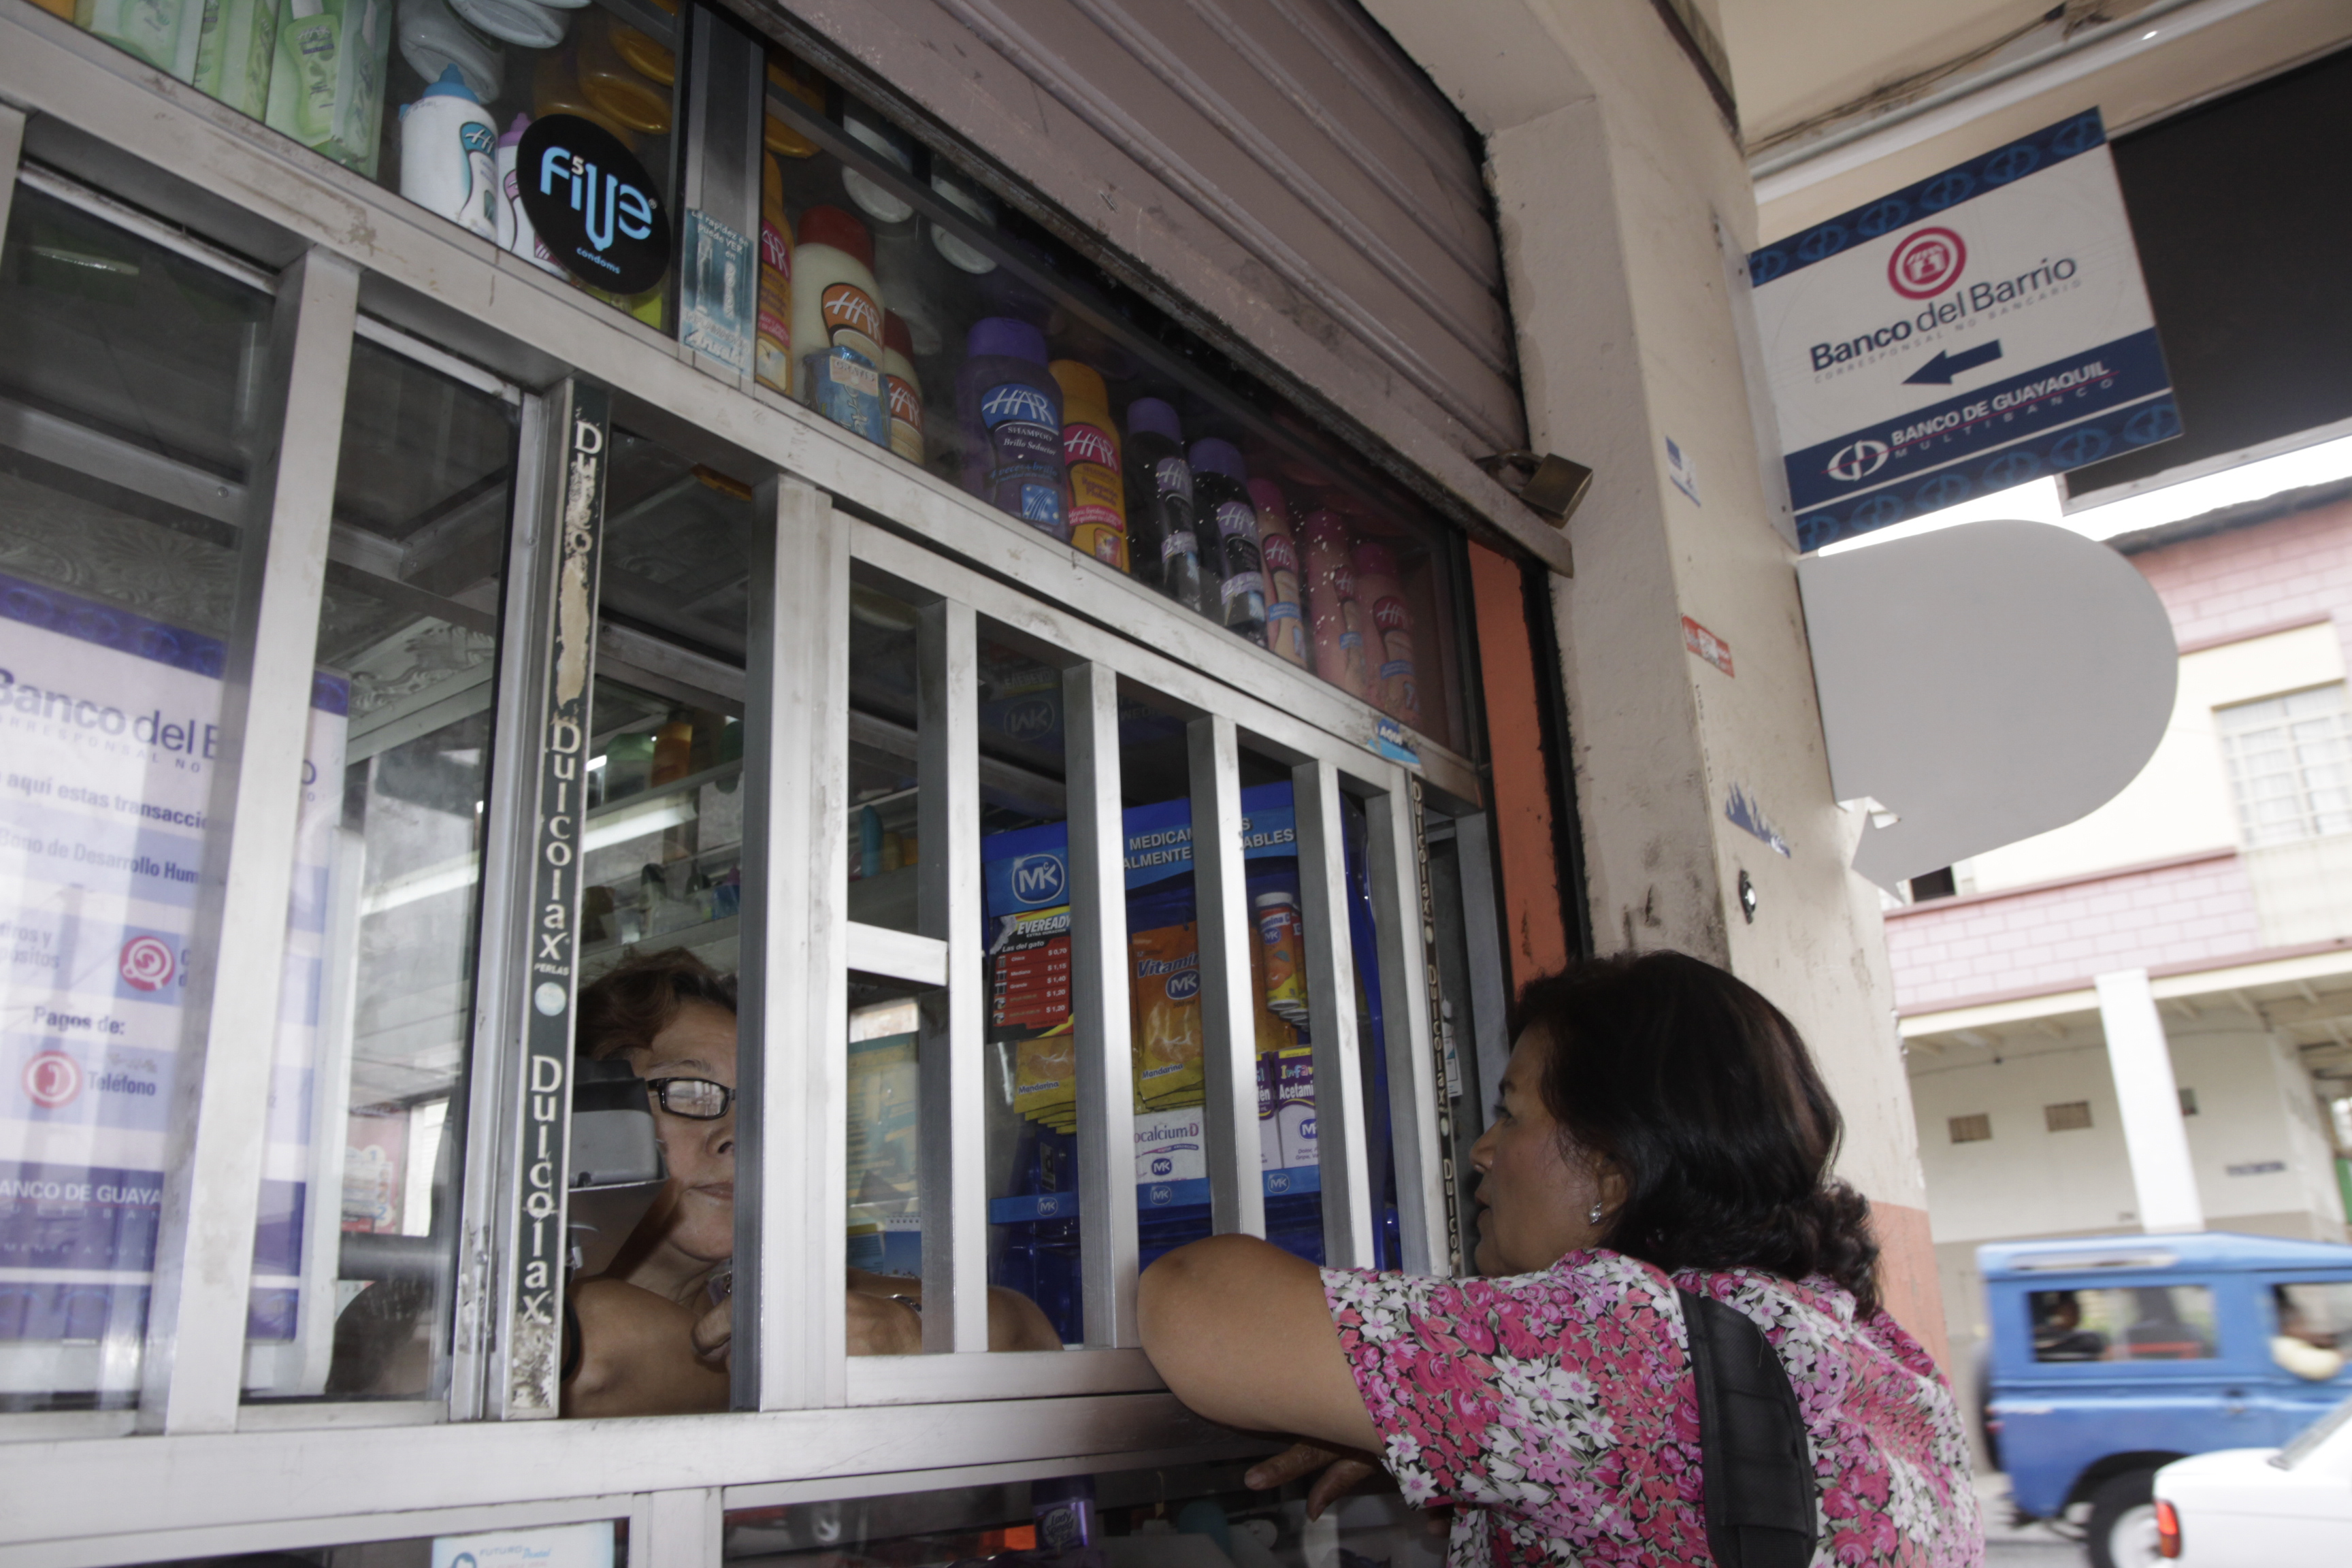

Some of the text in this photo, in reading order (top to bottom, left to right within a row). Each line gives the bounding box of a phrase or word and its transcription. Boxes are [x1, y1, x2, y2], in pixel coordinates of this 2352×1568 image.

[698, 223, 743, 256] puede VER
[576, 246, 621, 274] condoms
[1810, 257, 2078, 373] Banco del Barrio
[1814, 278, 2082, 385] CORRESPONSAL NO BANCARIO
[1891, 361, 2111, 446] BANCO DE GUAYAQUIL
[1895, 377, 2114, 460] MULTIBANCO
[1008, 426, 1053, 442] SHAMPOO
[1003, 438, 1057, 456] Brillo Seductor
[133, 708, 197, 755] del
[175, 758, 201, 774] NO
[7, 772, 52, 797] aquí
[57, 783, 110, 808] estas
[538, 722, 581, 961] Dulcolax
[48, 838, 69, 859] de
[73, 842, 161, 877] Desarrollo
[164, 861, 200, 884] Hum
[1124, 846, 1192, 870] ALMENTE
[1017, 915, 1071, 936] EVEREADY
[1016, 943, 1027, 951] del
[1028, 940, 1045, 950] gato
[534, 962, 570, 977] PERLAS
[33, 1004, 127, 1035] Pagos de:
[87, 1071, 157, 1096] Teléfono
[1142, 1063, 1185, 1080] Mandarina
[1018, 1081, 1060, 1095] Mandarina
[1279, 1081, 1314, 1100] Acetami
[1134, 1124, 1188, 1144] ocalcium
[0, 1178, 162, 1205] ANCO DE GUAYA
[523, 1055, 563, 1326] Dulcolax
[1046, 1518, 1074, 1538] Speed
[1051, 1512, 1072, 1526] Lady
